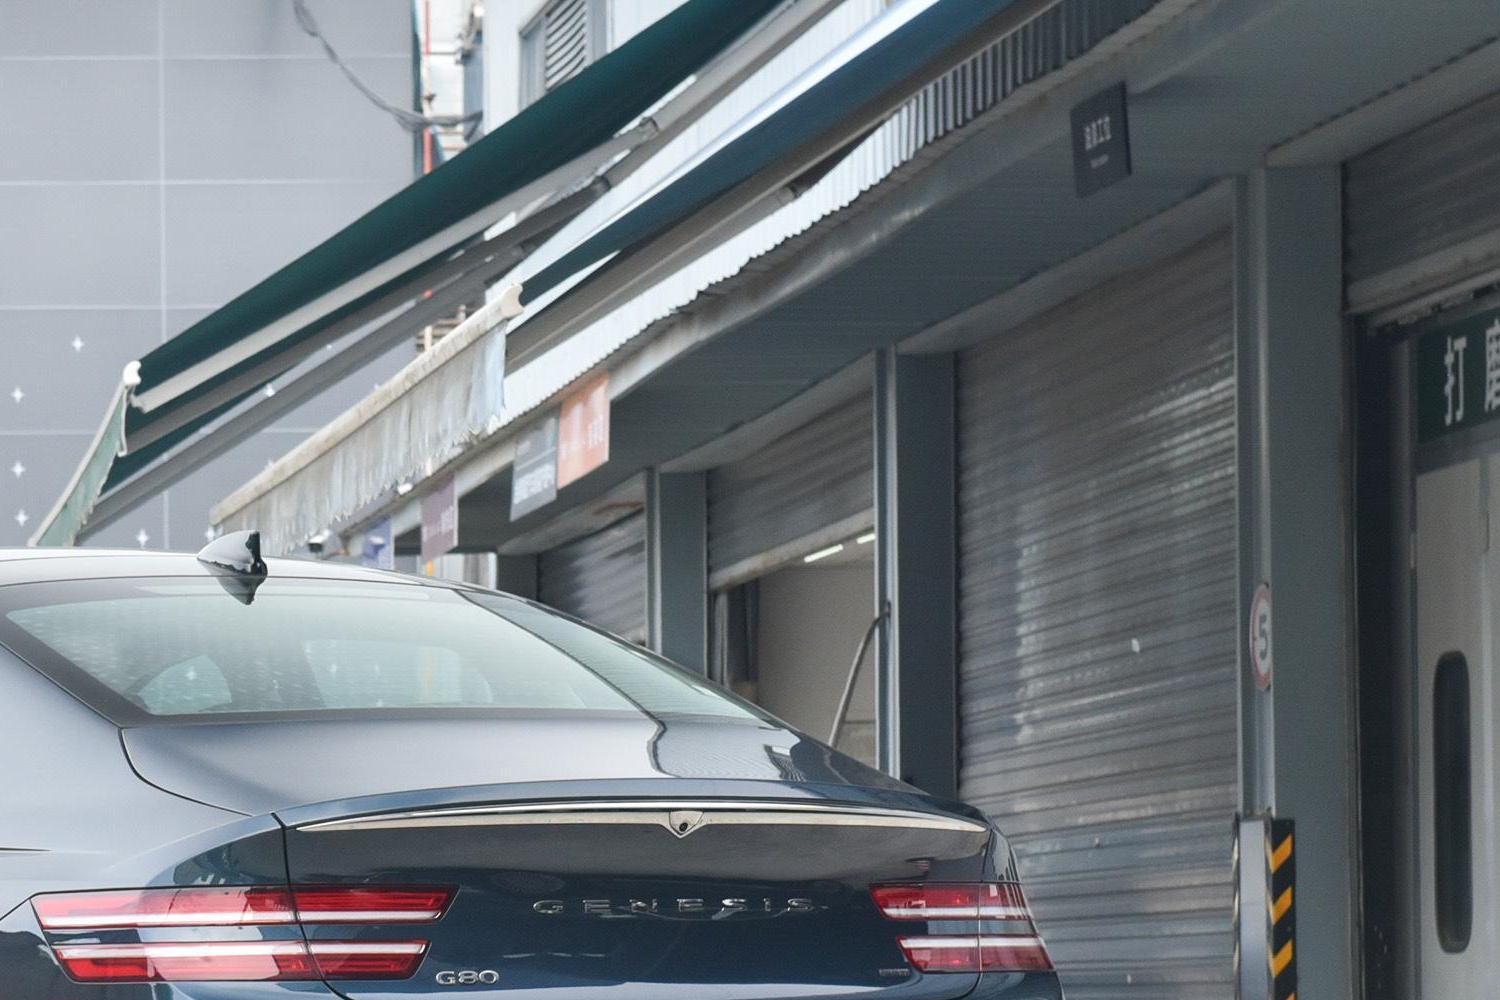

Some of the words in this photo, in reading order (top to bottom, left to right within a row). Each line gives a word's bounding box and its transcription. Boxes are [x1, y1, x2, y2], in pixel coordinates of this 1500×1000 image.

[1258, 614, 1269, 660] 5
[533, 898, 815, 914] GENESIS
[436, 970, 499, 985] G80
